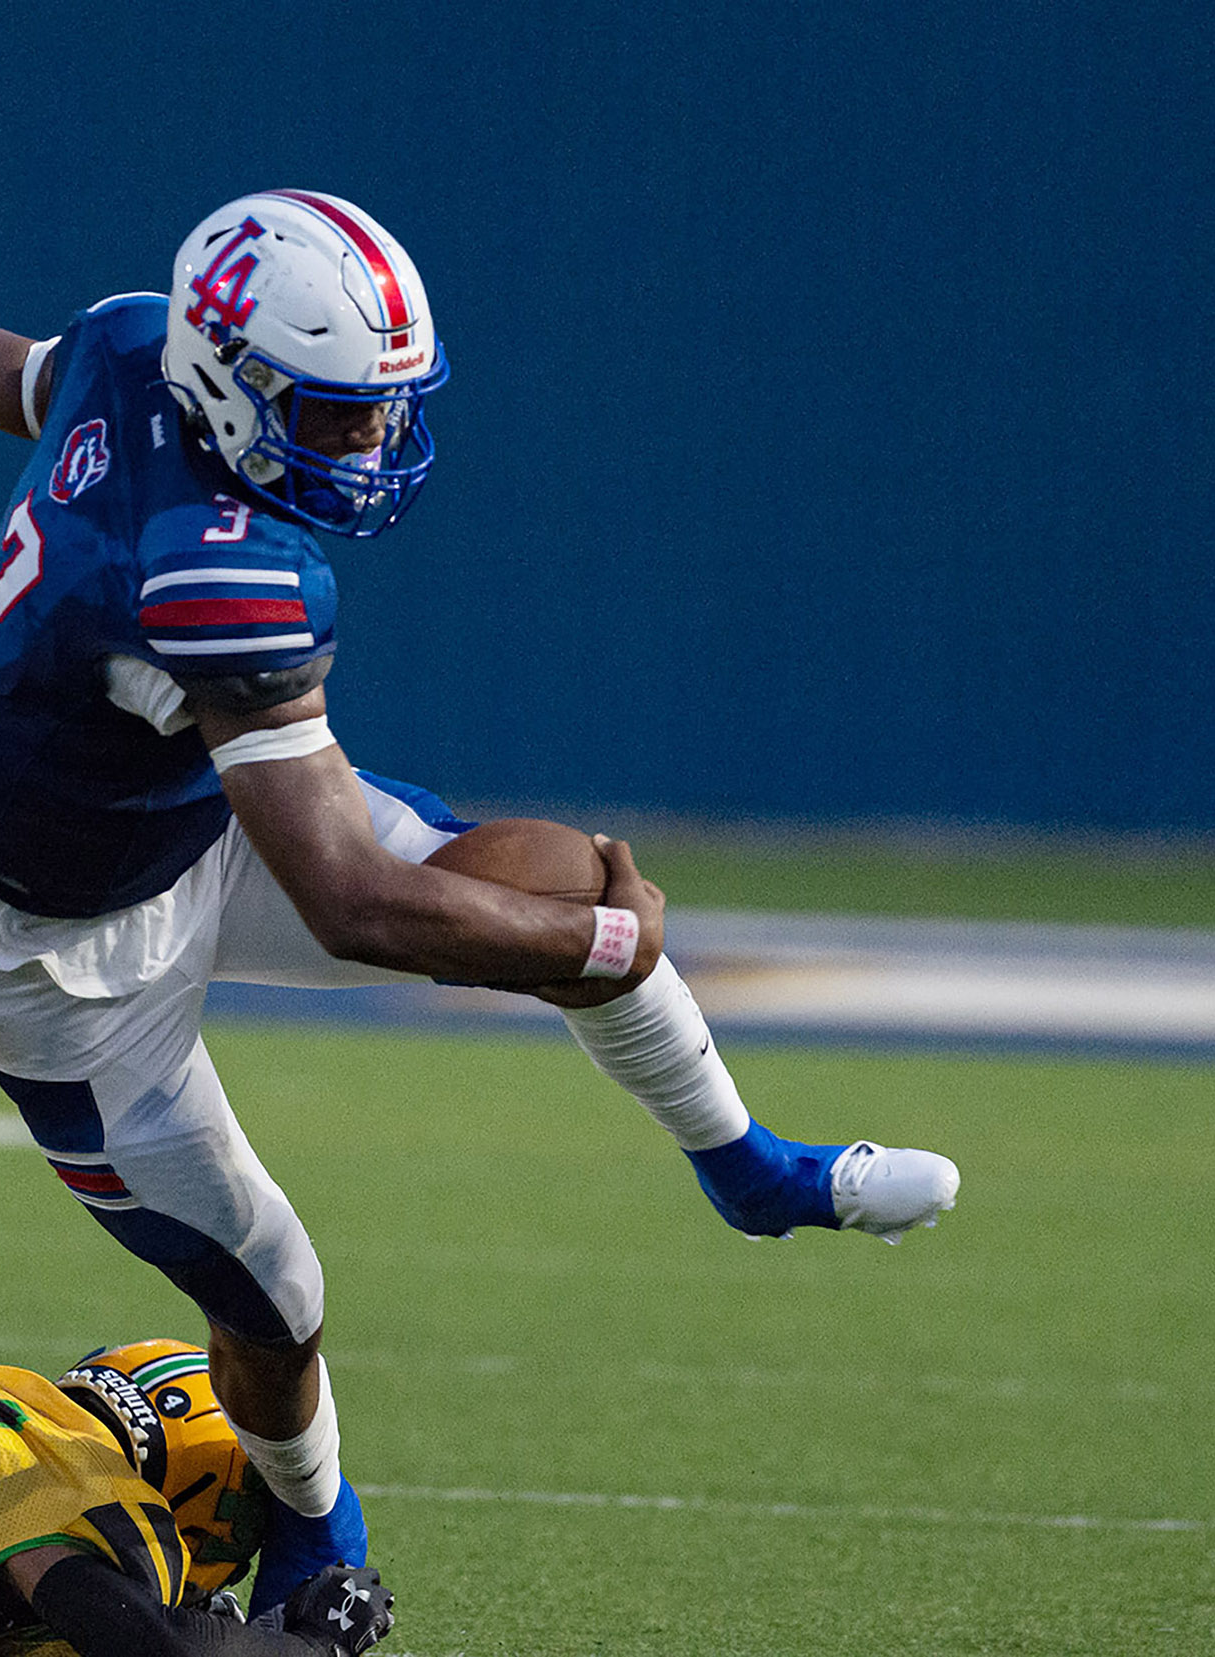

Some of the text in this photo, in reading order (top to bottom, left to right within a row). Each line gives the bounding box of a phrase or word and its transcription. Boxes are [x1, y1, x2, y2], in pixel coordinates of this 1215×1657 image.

[185, 216, 265, 346] LA
[379, 351, 424, 374] Riddell
[201, 493, 253, 544] 3
[163, 1394, 185, 1411] 4
